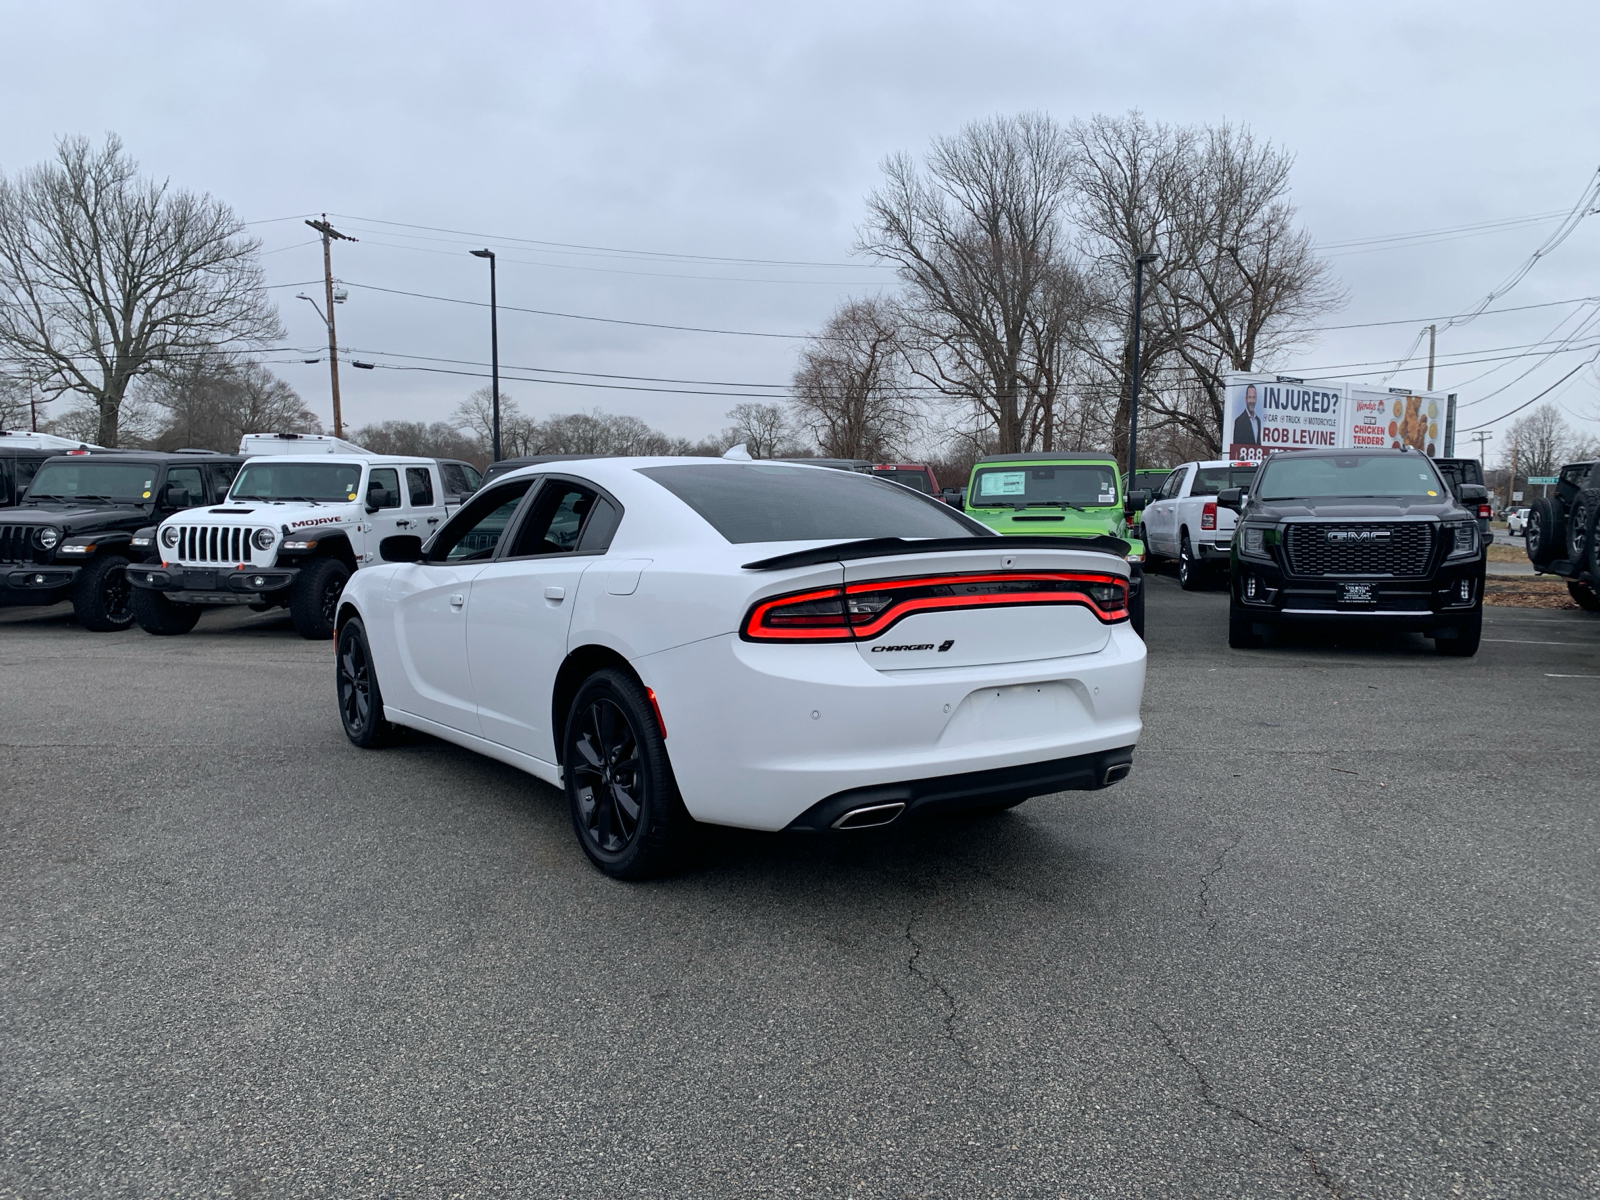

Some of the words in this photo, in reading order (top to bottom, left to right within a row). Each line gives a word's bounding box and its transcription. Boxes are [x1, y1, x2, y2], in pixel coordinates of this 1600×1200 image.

[1263, 386, 1339, 414] INJURED?
[1356, 400, 1377, 413] Wendy's
[1267, 414, 1278, 422] CAR
[1286, 416, 1301, 424] TRUCK
[1308, 417, 1337, 427] MOTORCYCLE
[1364, 416, 1376, 425] NEW
[1353, 425, 1385, 435] CHICKEN
[1262, 427, 1290, 443] ROB
[1292, 429, 1335, 446] LEVINE
[1353, 435, 1385, 445] TENDERS
[291, 516, 342, 528] MOJAVE
[1327, 531, 1391, 542] GMC
[871, 643, 935, 652] CHARGER
